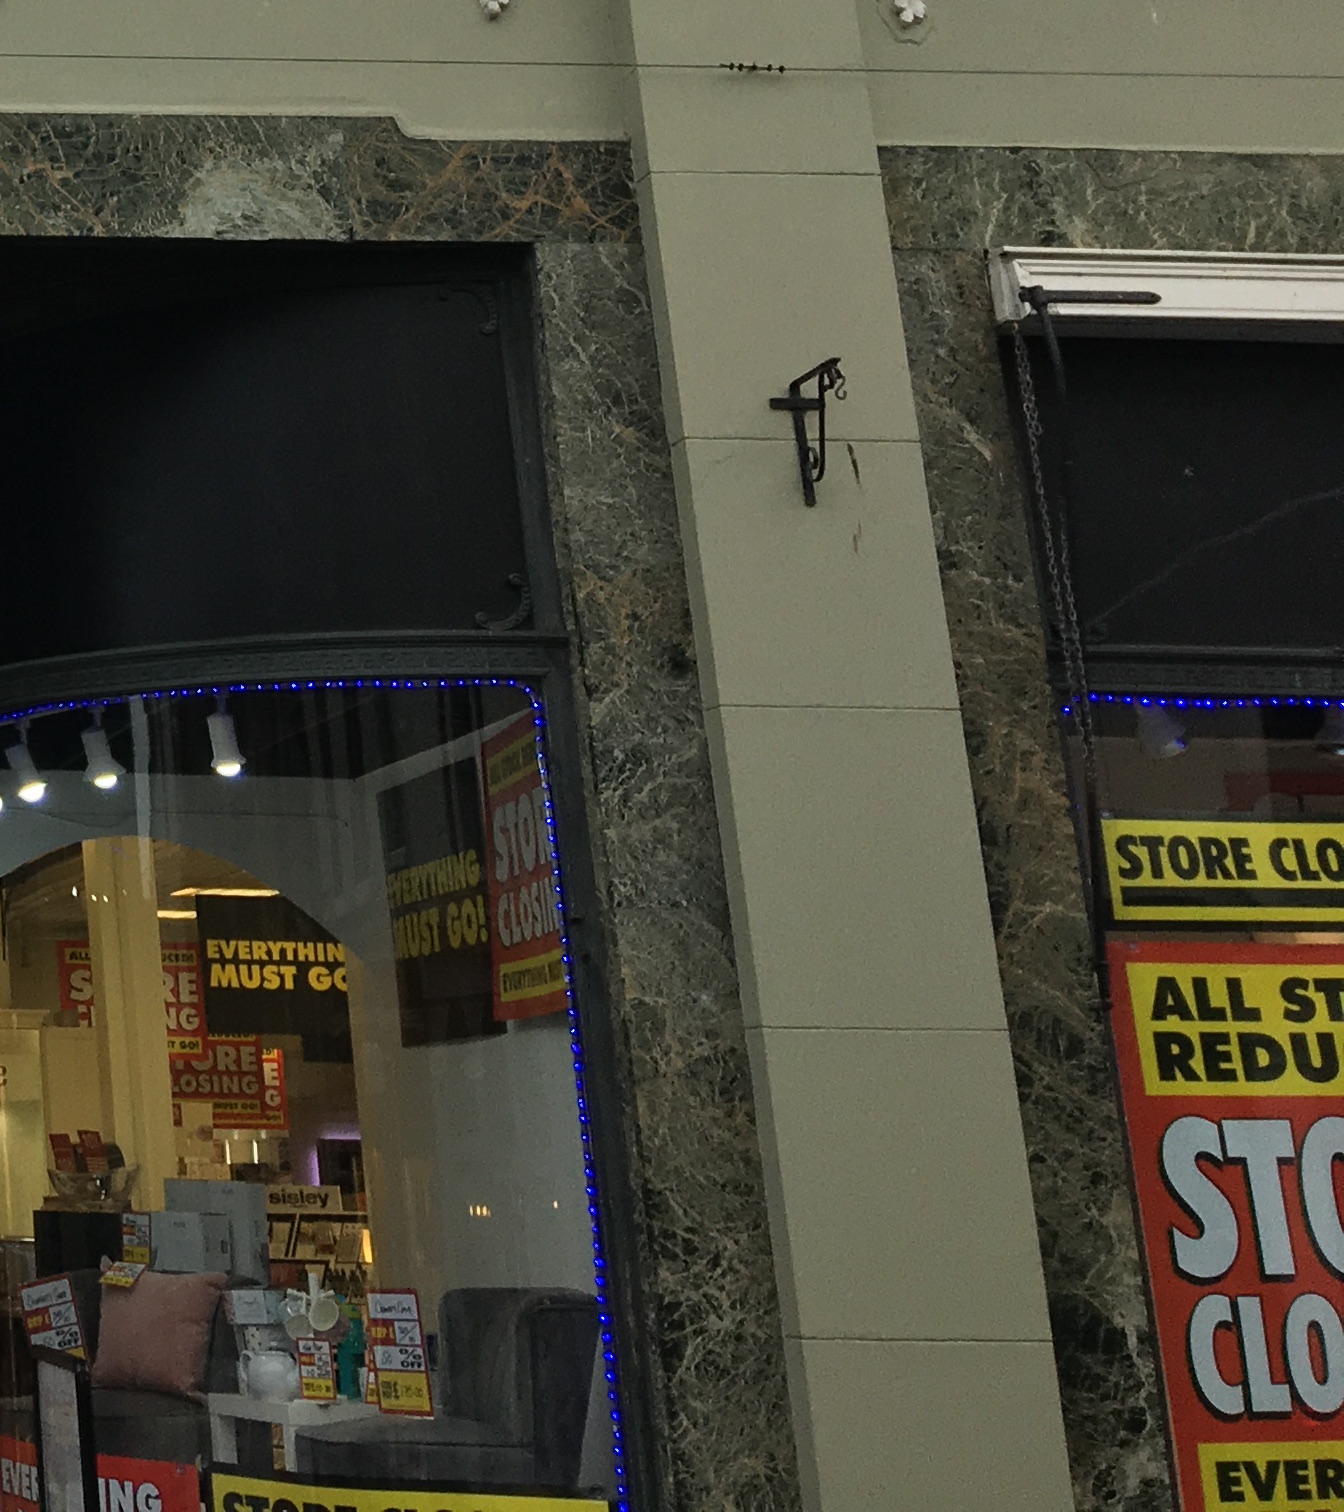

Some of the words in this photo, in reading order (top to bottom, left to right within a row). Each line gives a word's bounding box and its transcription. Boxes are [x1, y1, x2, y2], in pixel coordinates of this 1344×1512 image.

[1114, 834, 1258, 881] STORE
[447, 894, 489, 950] GO!
[210, 964, 297, 990] MUST
[1150, 976, 1263, 1022] ALL
[268, 1188, 329, 1209] sisley
